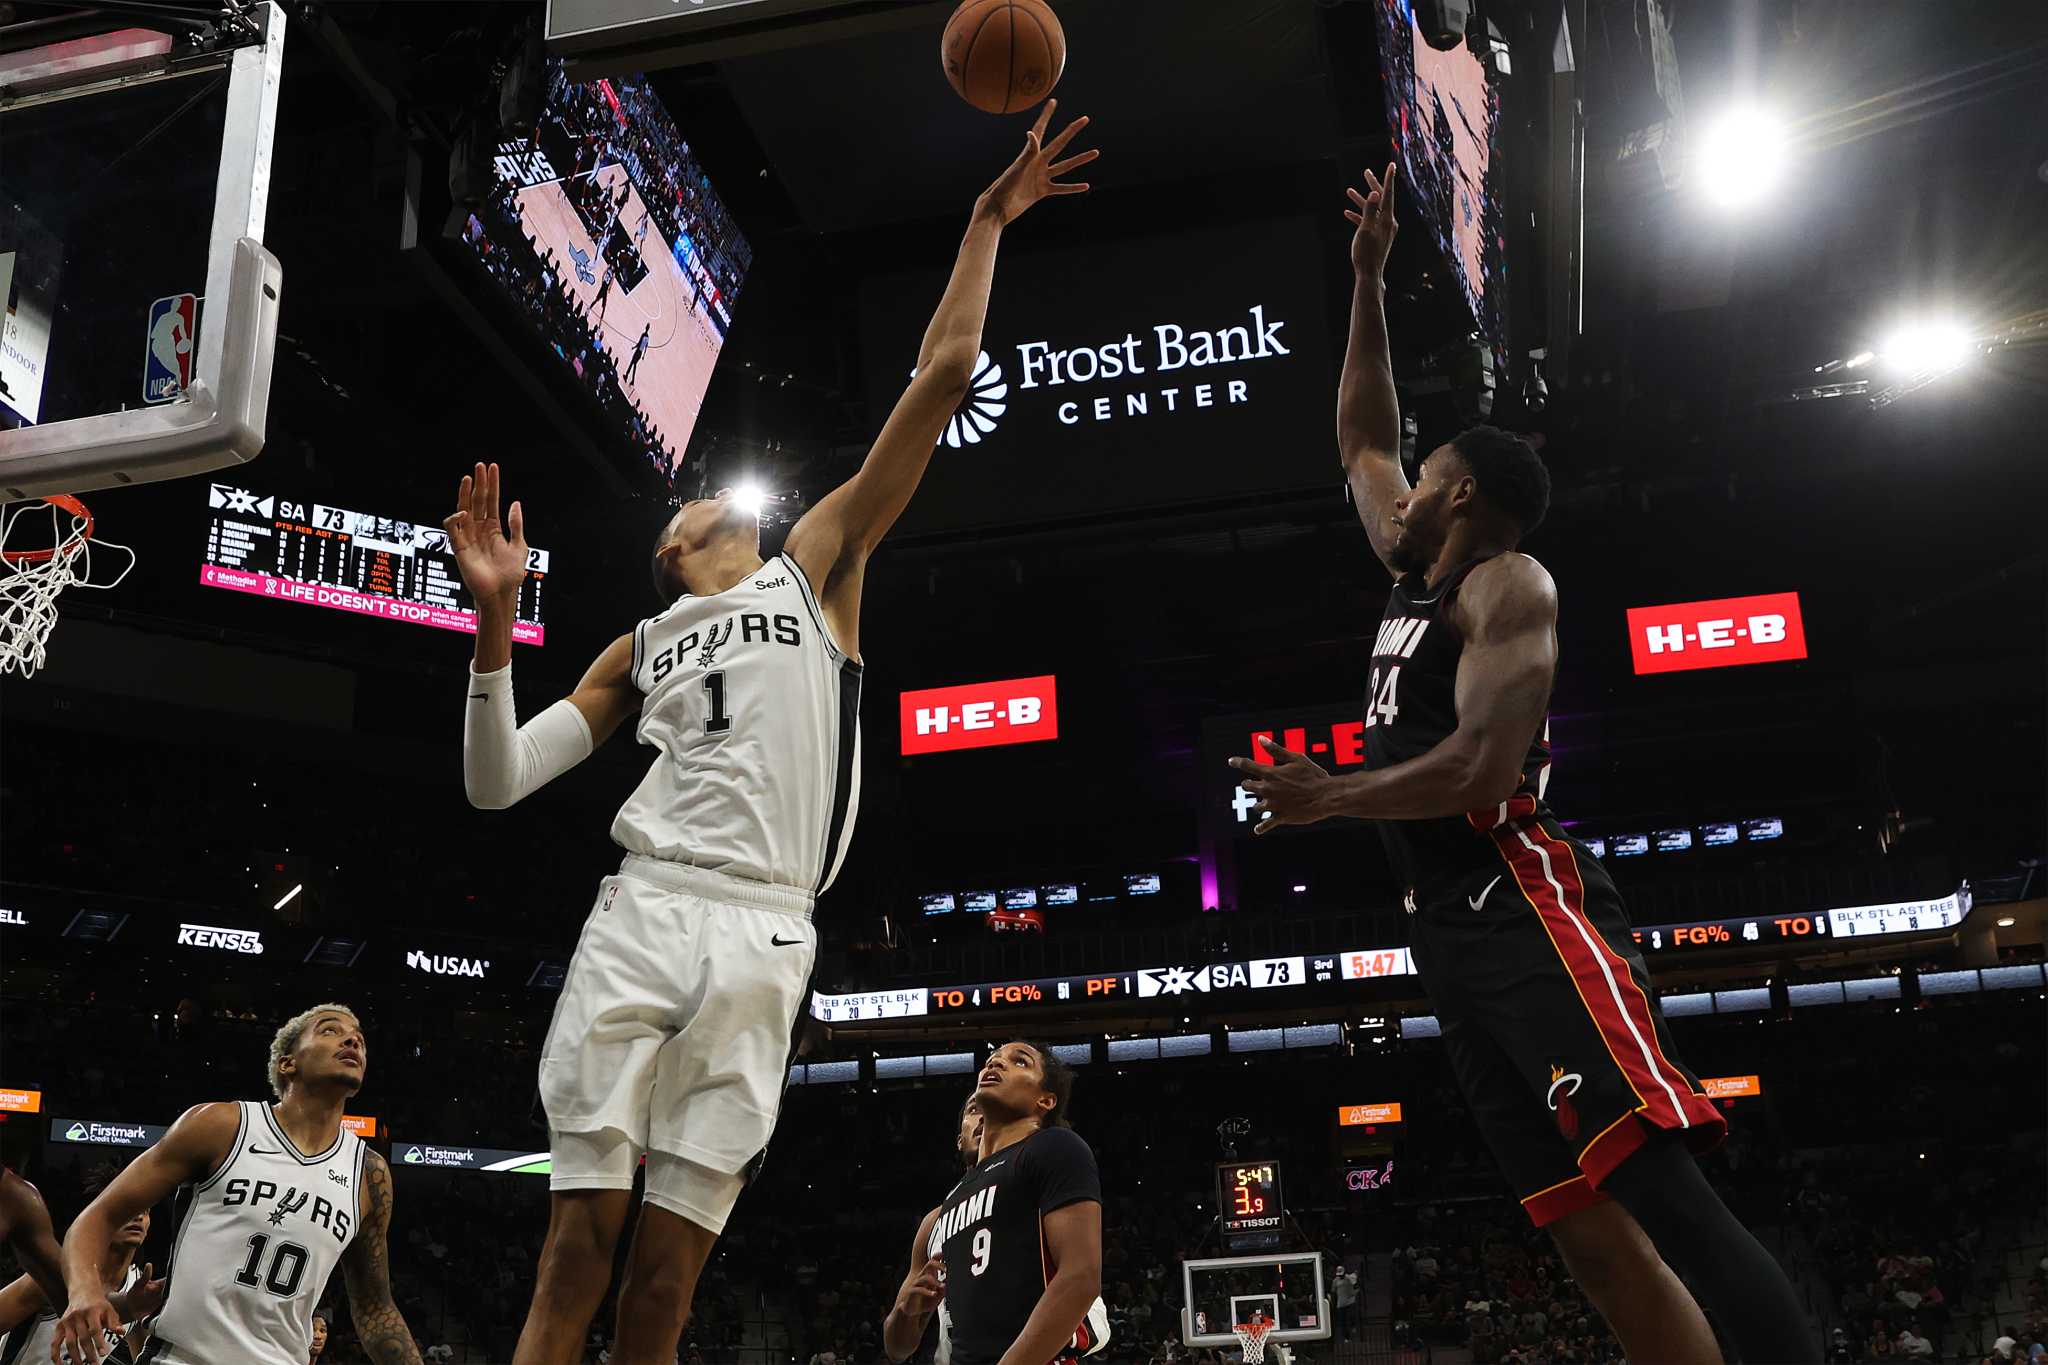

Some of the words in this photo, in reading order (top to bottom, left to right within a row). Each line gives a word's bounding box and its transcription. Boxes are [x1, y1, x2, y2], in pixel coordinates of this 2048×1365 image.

[1016, 333, 1145, 389] Frost
[1153, 304, 1290, 371] Bank
[1058, 379, 1248, 425] CENTER
[279, 501, 306, 522] SA
[321, 507, 345, 531] 73
[217, 572, 257, 587] Methodist
[755, 576, 791, 590] Self.
[280, 583, 315, 601] LIFE
[317, 589, 387, 613] DOESN'T
[389, 603, 431, 621] STOP
[1645, 613, 1787, 655] H-E-B
[652, 613, 801, 685] SPURS
[702, 669, 733, 736] 1
[1365, 665, 1401, 729] 24
[915, 696, 1043, 736] H-E-B
[1837, 911, 1863, 922] BLK
[1868, 907, 1896, 919] STL
[1899, 905, 1925, 916] AST
[1673, 925, 1731, 946] FG%
[1774, 917, 1811, 936] TO
[433, 954, 485, 979] USAA
[1212, 964, 1248, 988] SA
[1264, 961, 1290, 985] 73
[1313, 959, 1334, 970] 3rd
[1351, 953, 1396, 977] 5:47
[843, 996, 866, 1006] AST
[870, 995, 893, 1004] STL
[896, 993, 919, 1002] BLK
[932, 990, 965, 1008] TO
[971, 989, 981, 1007] 4
[991, 984, 1042, 1004] FG%
[1086, 977, 1118, 996] PF
[1123, 976, 1131, 994] 1
[848, 1006, 859, 1019] 20
[877, 1005, 883, 1017] 5
[904, 1003, 909, 1015] 7
[89, 1123, 146, 1140] Firstmark
[89, 1134, 110, 1143] Credit
[425, 1147, 474, 1162] Firstmark
[328, 1168, 350, 1189] Self.
[1236, 1167, 1273, 1186] 5:47
[222, 1177, 351, 1244] SPURS
[1234, 1186, 1264, 1215] 3.9
[1240, 1216, 1280, 1228] TISSOT
[234, 1231, 311, 1299] 10
[971, 1227, 992, 1277] 9
